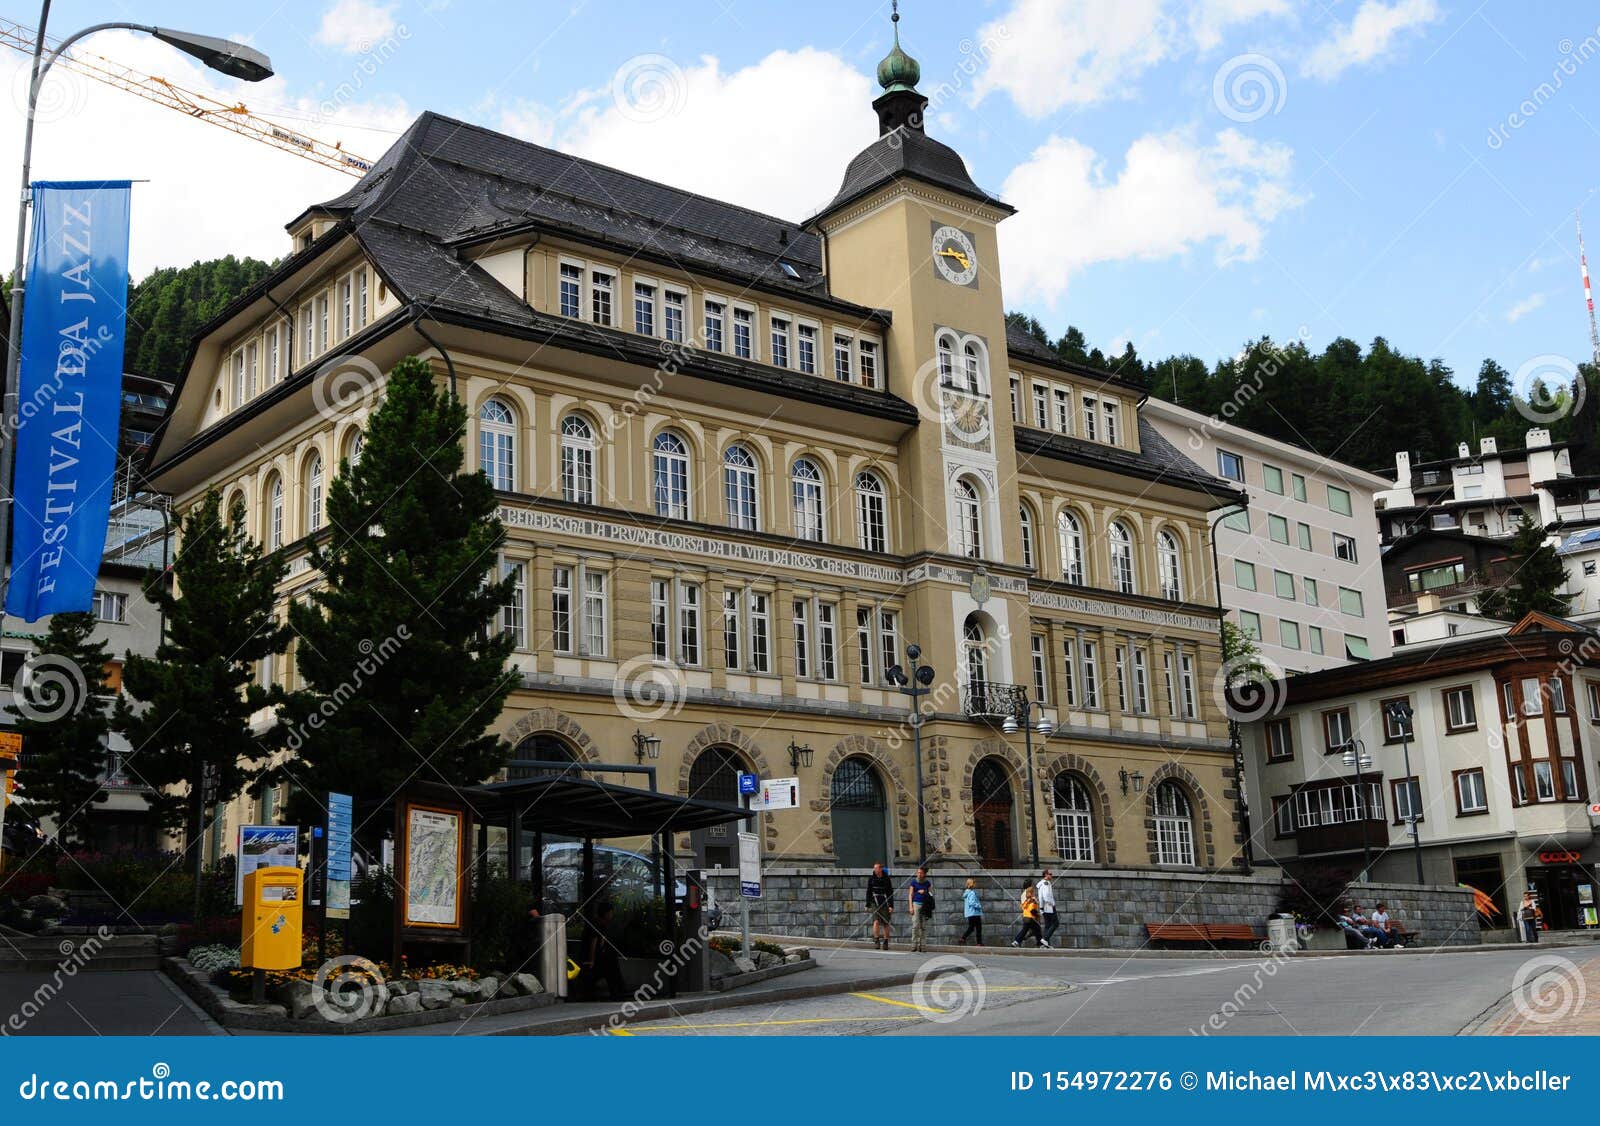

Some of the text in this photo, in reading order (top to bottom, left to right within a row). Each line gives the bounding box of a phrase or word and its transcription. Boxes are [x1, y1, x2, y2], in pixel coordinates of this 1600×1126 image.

[36, 201, 97, 598] FESTIVAL DA JAZZ
[591, 521, 605, 536] LA
[709, 541, 724, 554] DA
[729, 544, 742, 558] LA
[746, 547, 769, 562] VITA
[775, 552, 789, 565] DA
[1539, 852, 1581, 864] coop
